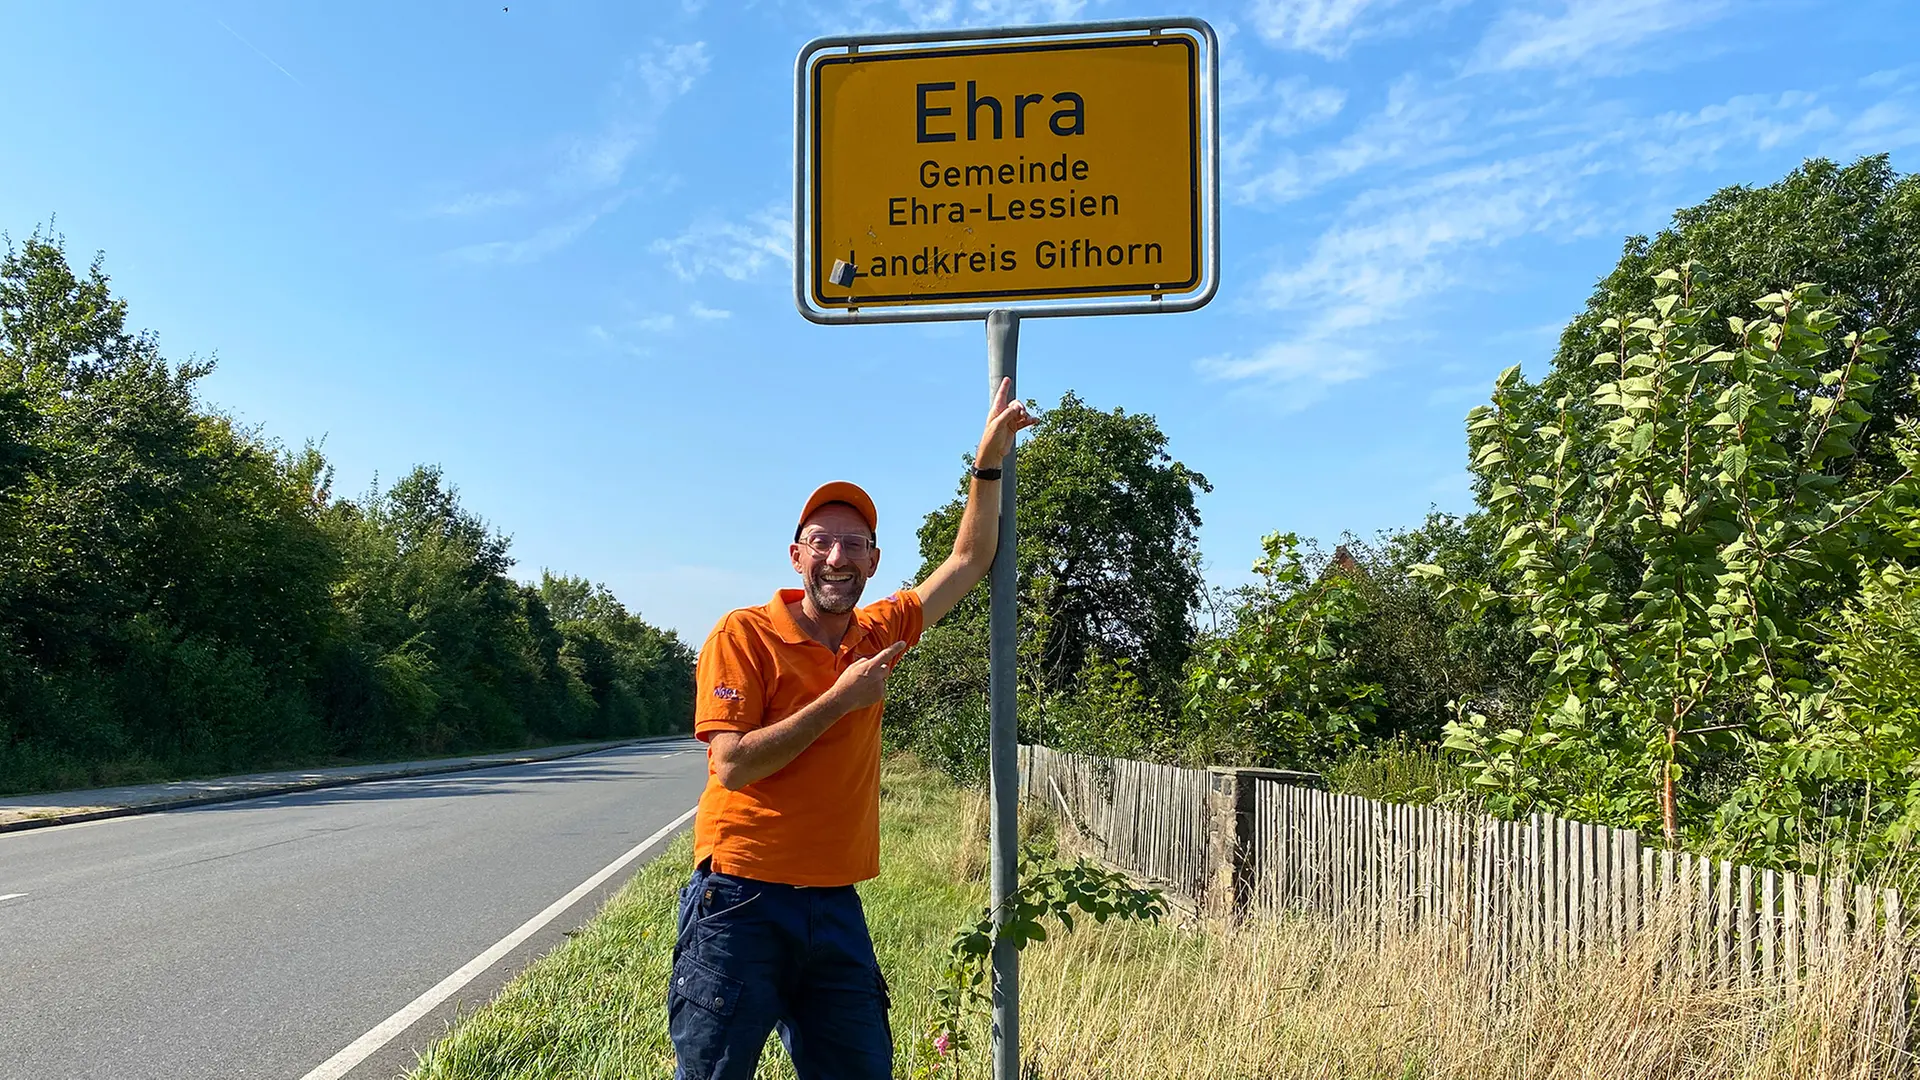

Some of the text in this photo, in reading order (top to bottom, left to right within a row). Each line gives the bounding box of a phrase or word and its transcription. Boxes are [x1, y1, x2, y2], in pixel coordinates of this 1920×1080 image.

[916, 80, 1085, 144] Ehra
[919, 153, 1089, 189] Gemeinde
[888, 189, 1119, 226] Ehra-Lessien
[850, 239, 1162, 278] Landkreis Gifhorn
